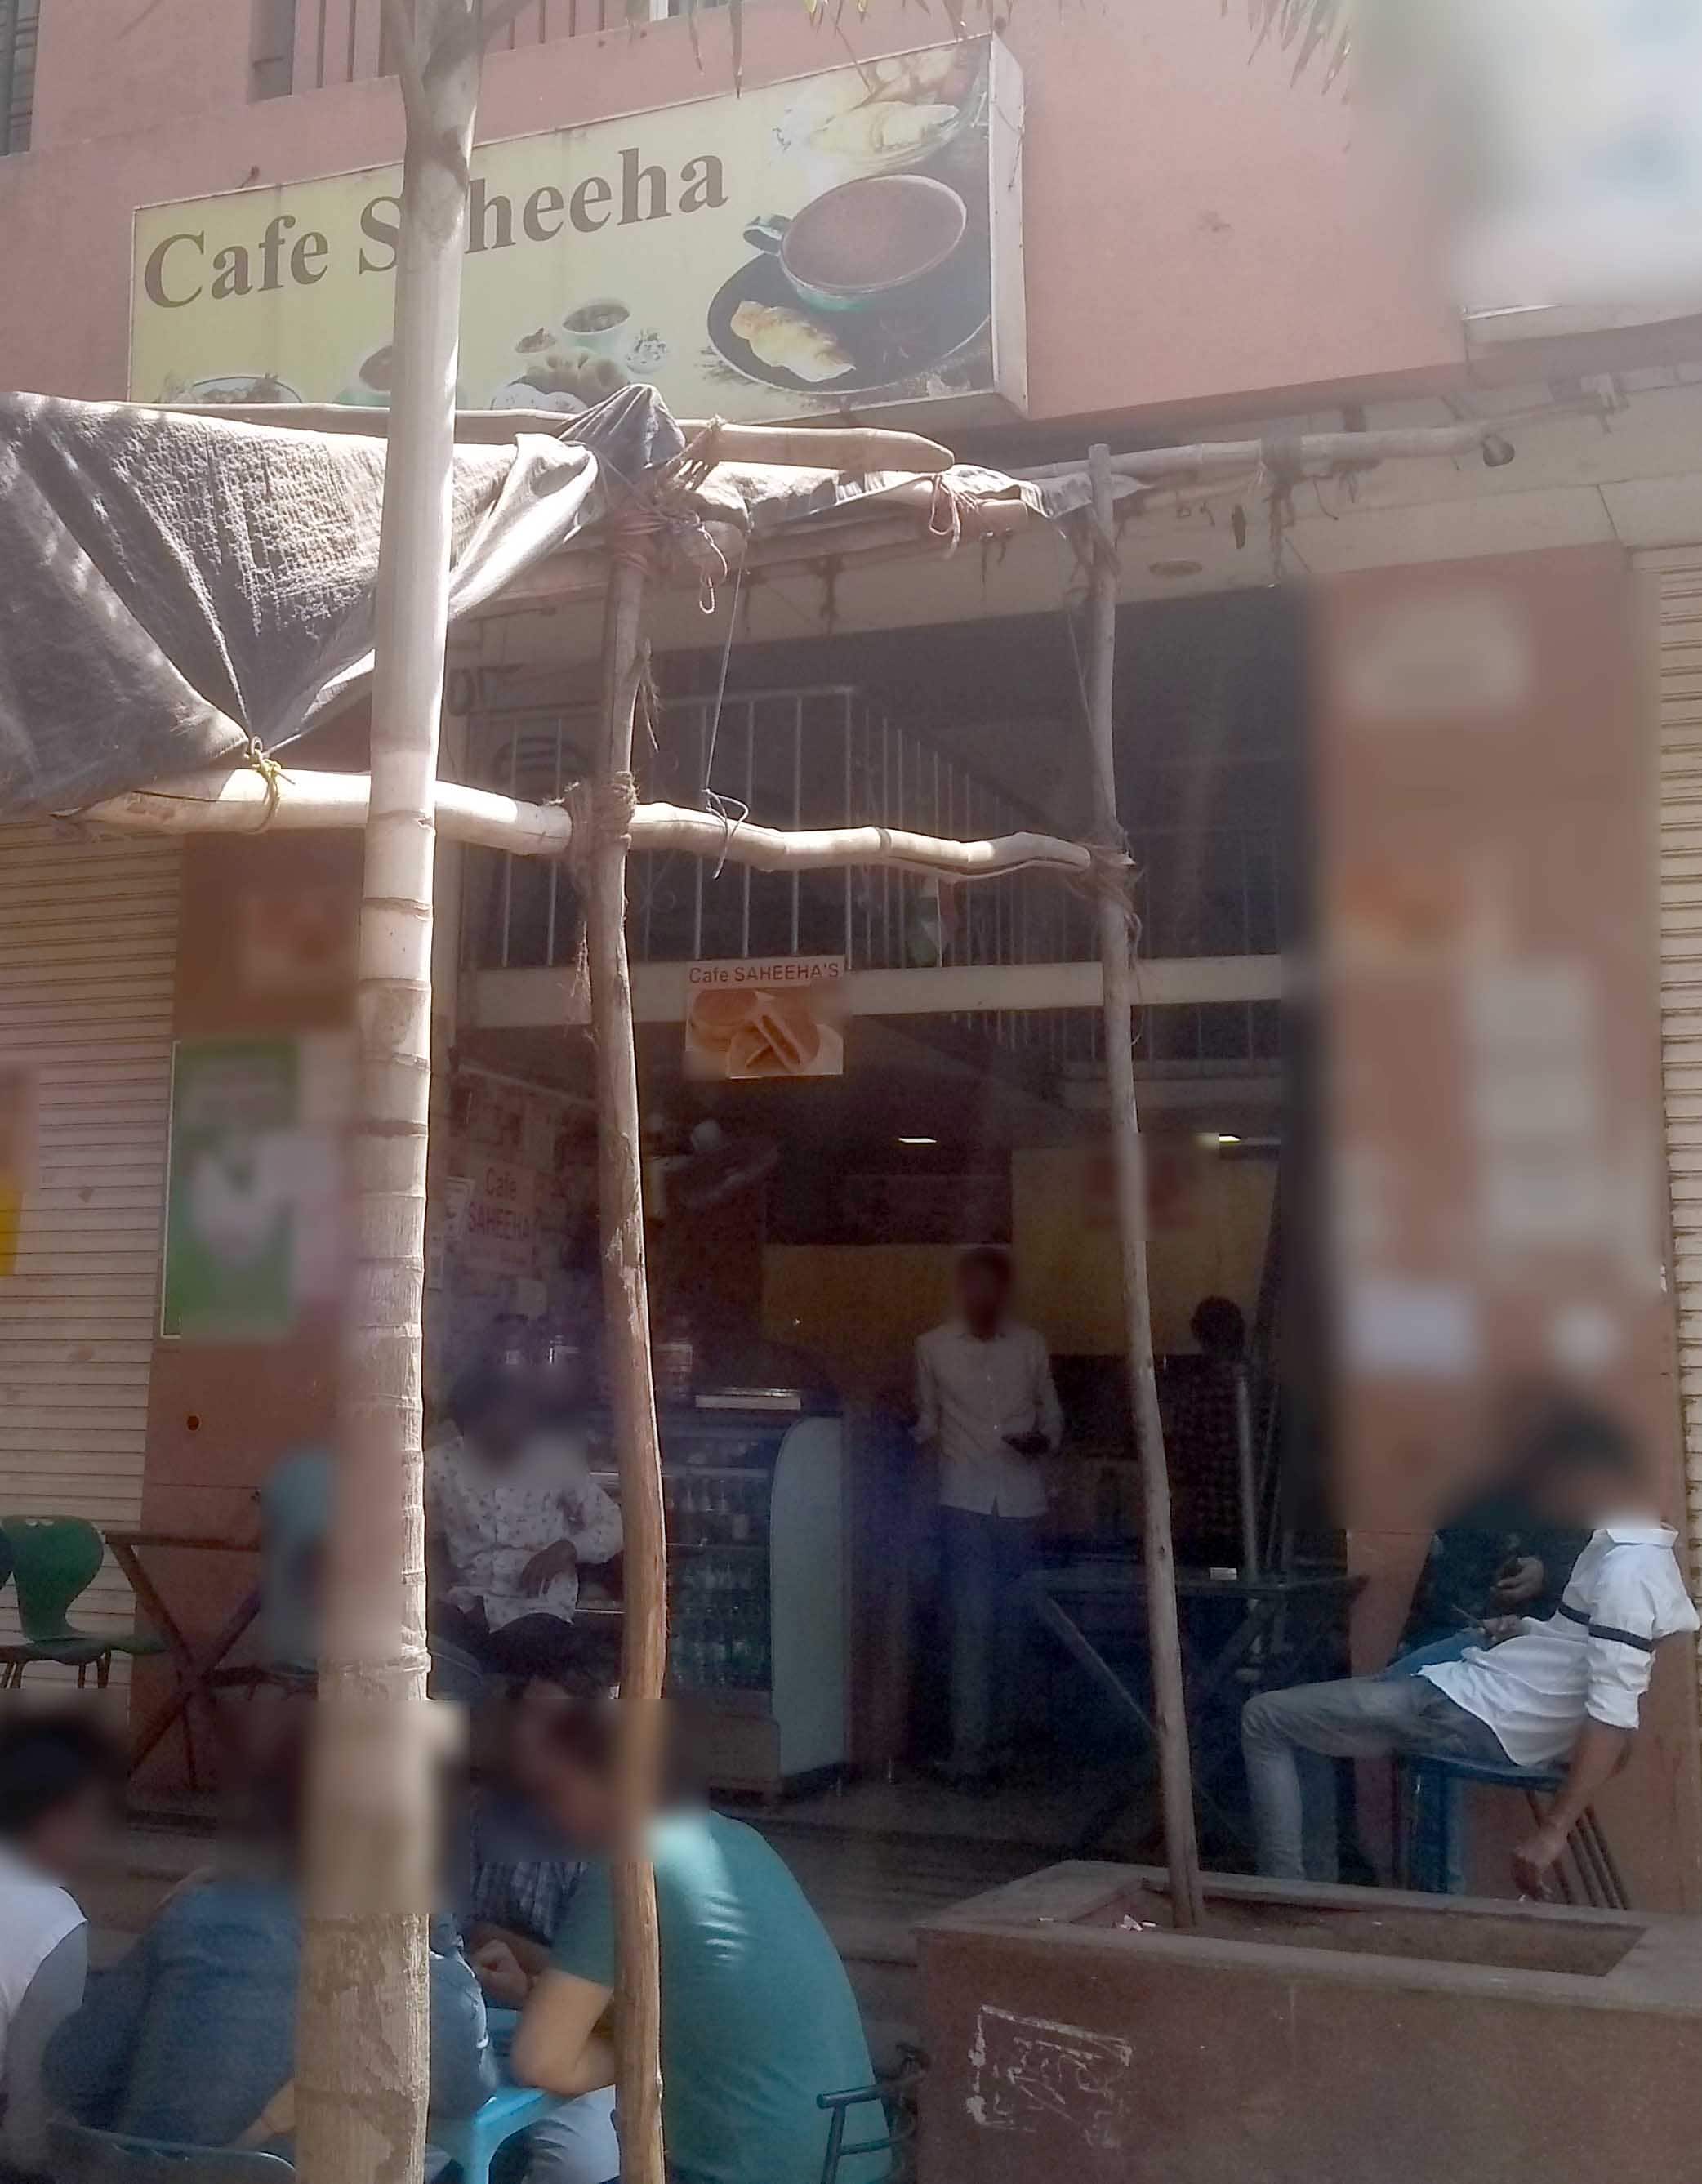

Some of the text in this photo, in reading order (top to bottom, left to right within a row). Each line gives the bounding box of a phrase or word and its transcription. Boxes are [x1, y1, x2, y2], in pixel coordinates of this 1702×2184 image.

[145, 148, 729, 309] Cafe Sheeha
[689, 963, 839, 983] Cafe SAHEEHA'S
[485, 1166, 518, 1201] Cafe
